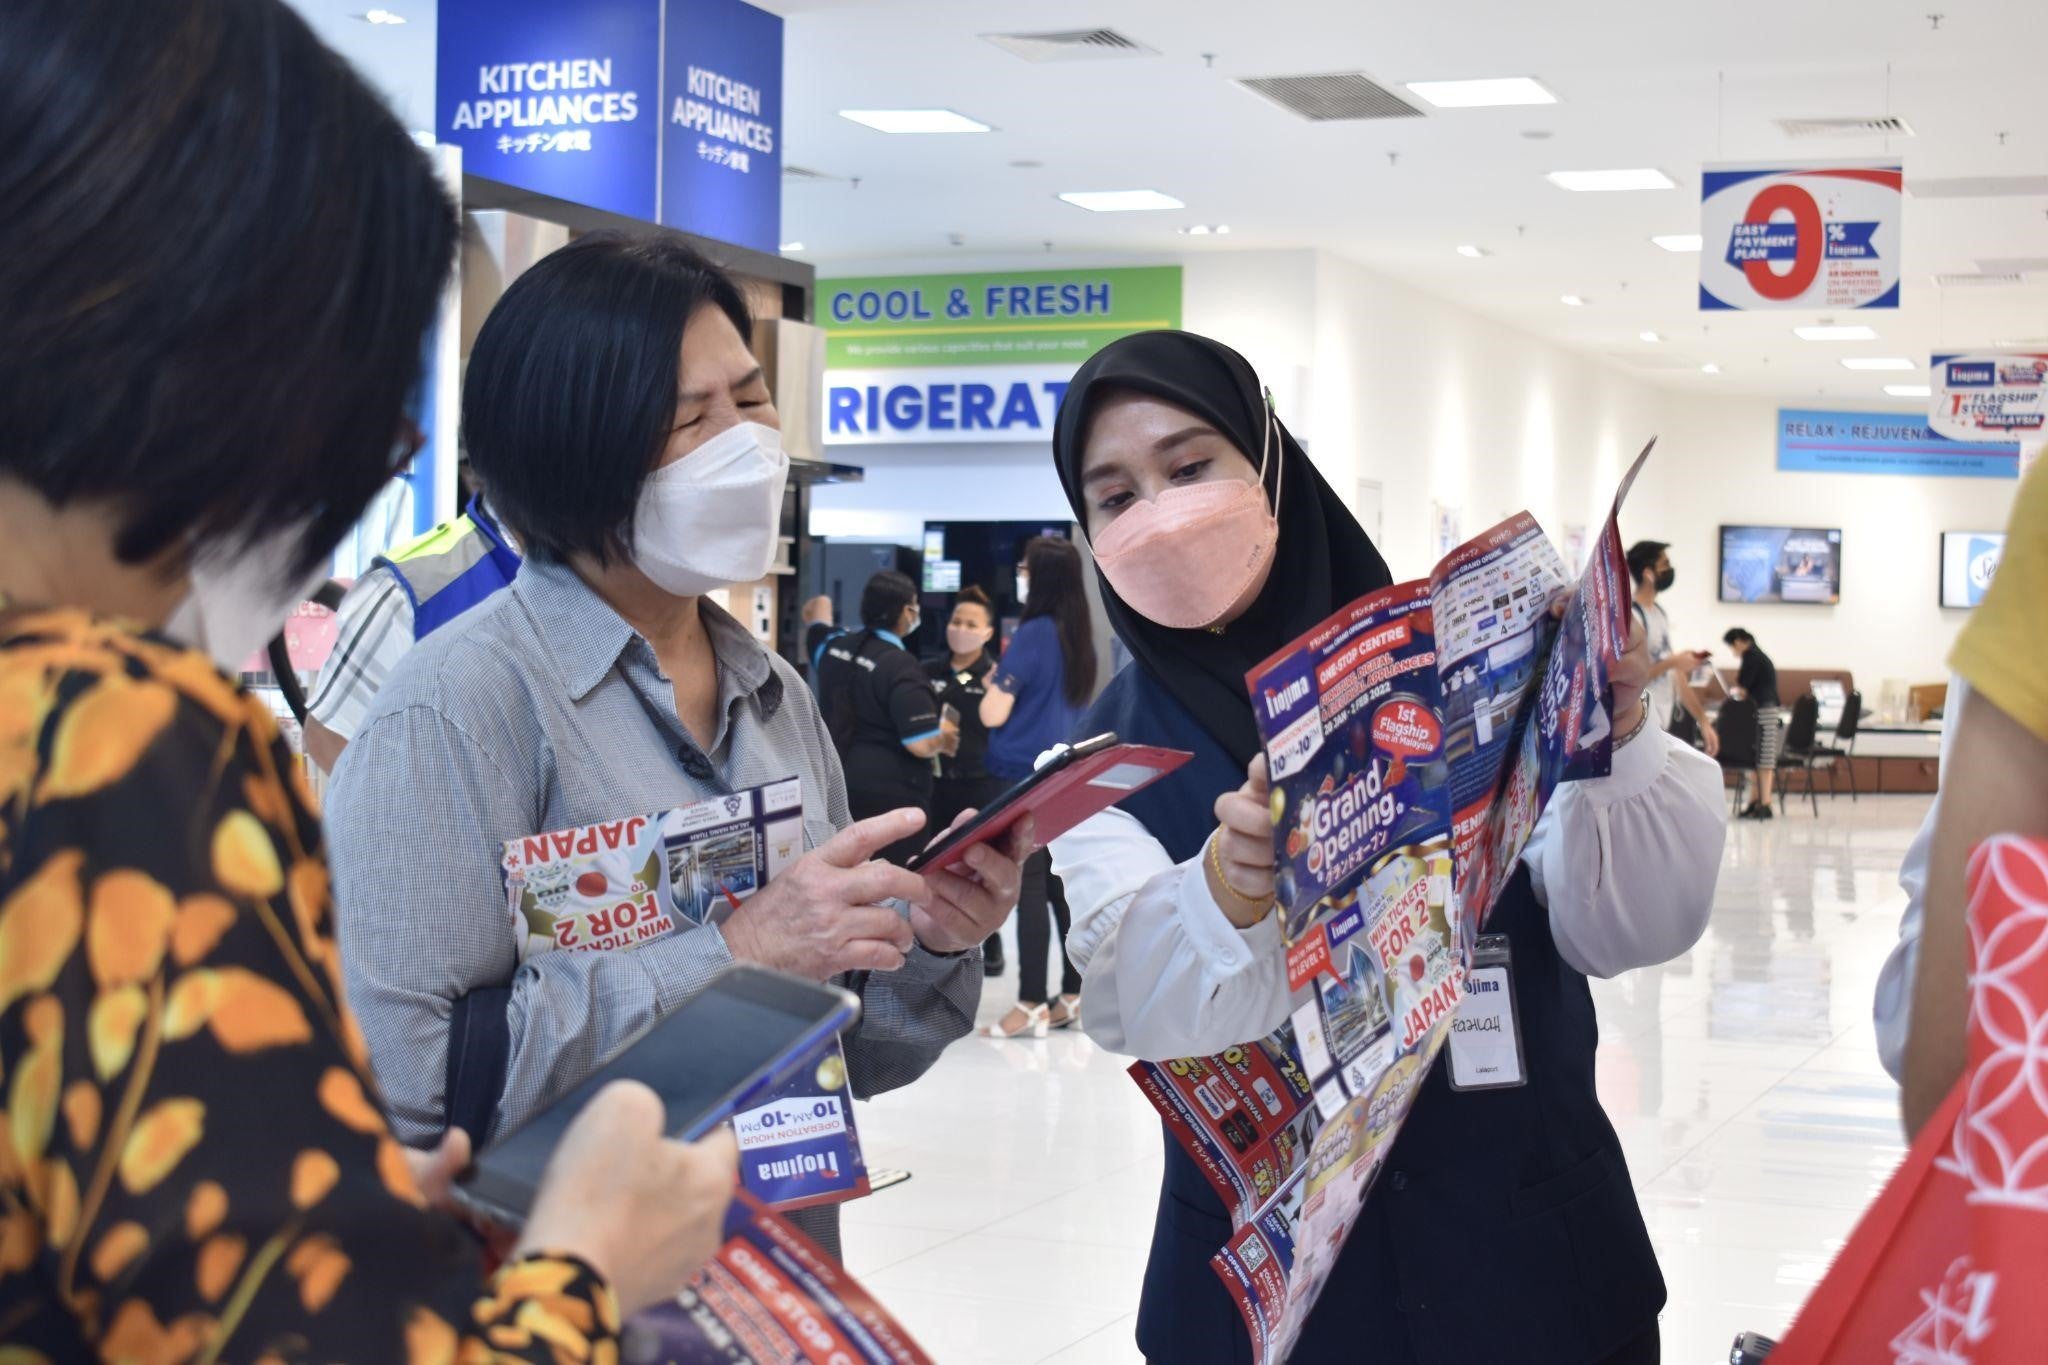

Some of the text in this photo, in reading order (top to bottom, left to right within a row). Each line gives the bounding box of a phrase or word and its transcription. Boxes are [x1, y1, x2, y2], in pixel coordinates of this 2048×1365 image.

[479, 58, 611, 94] KITCHEN
[687, 65, 760, 117] KITCHEN
[452, 92, 638, 130] APPLIANCES
[672, 97, 773, 154] APPLIANCES
[1733, 236, 1796, 247] PAYMENT
[1734, 225, 1768, 236] EASY
[1742, 184, 1823, 301] 0
[1733, 249, 1768, 259] PLAN
[832, 283, 1111, 322] COOL & FRESH
[829, 381, 1070, 433] RIGERAT
[1973, 394, 2038, 403] FLAGSHIP
[1785, 423, 1834, 438] RELAX
[1320, 626, 1405, 685] ONE-STOP CENTRE
[1367, 652, 1436, 687] APPLIANCES
[1264, 675, 1311, 719] nojima
[1369, 681, 1391, 700] 2022
[1380, 716, 1430, 740] Flagship
[1397, 705, 1417, 722] 1st
[1313, 758, 1382, 838] Grand
[690, 821, 750, 841] JALAN HANG TUAH
[1325, 829, 1389, 887] グランドオープン
[631, 882, 645, 893] TO
[555, 893, 660, 947] FOR 2
[637, 917, 672, 939] WIN
[1332, 912, 1360, 939] nojima
[1369, 878, 1428, 947] WIN TICKETS
[1380, 899, 1430, 969] FOR 2
[1297, 952, 1318, 976] LEVEL
[1318, 947, 1325, 959] 3
[1466, 979, 1499, 995] ojima
[1166, 1088, 1186, 1114] GRAND
[1184, 1113, 1210, 1145] OPENING
[1243, 1097, 1263, 1122] DIVAN
[743, 1120, 840, 1145] OPERATION HOUR
[758, 1151, 840, 1181] nojima
[1227, 1255, 1250, 1288] OPENING
[728, 1246, 834, 1351] ONE-STOP
